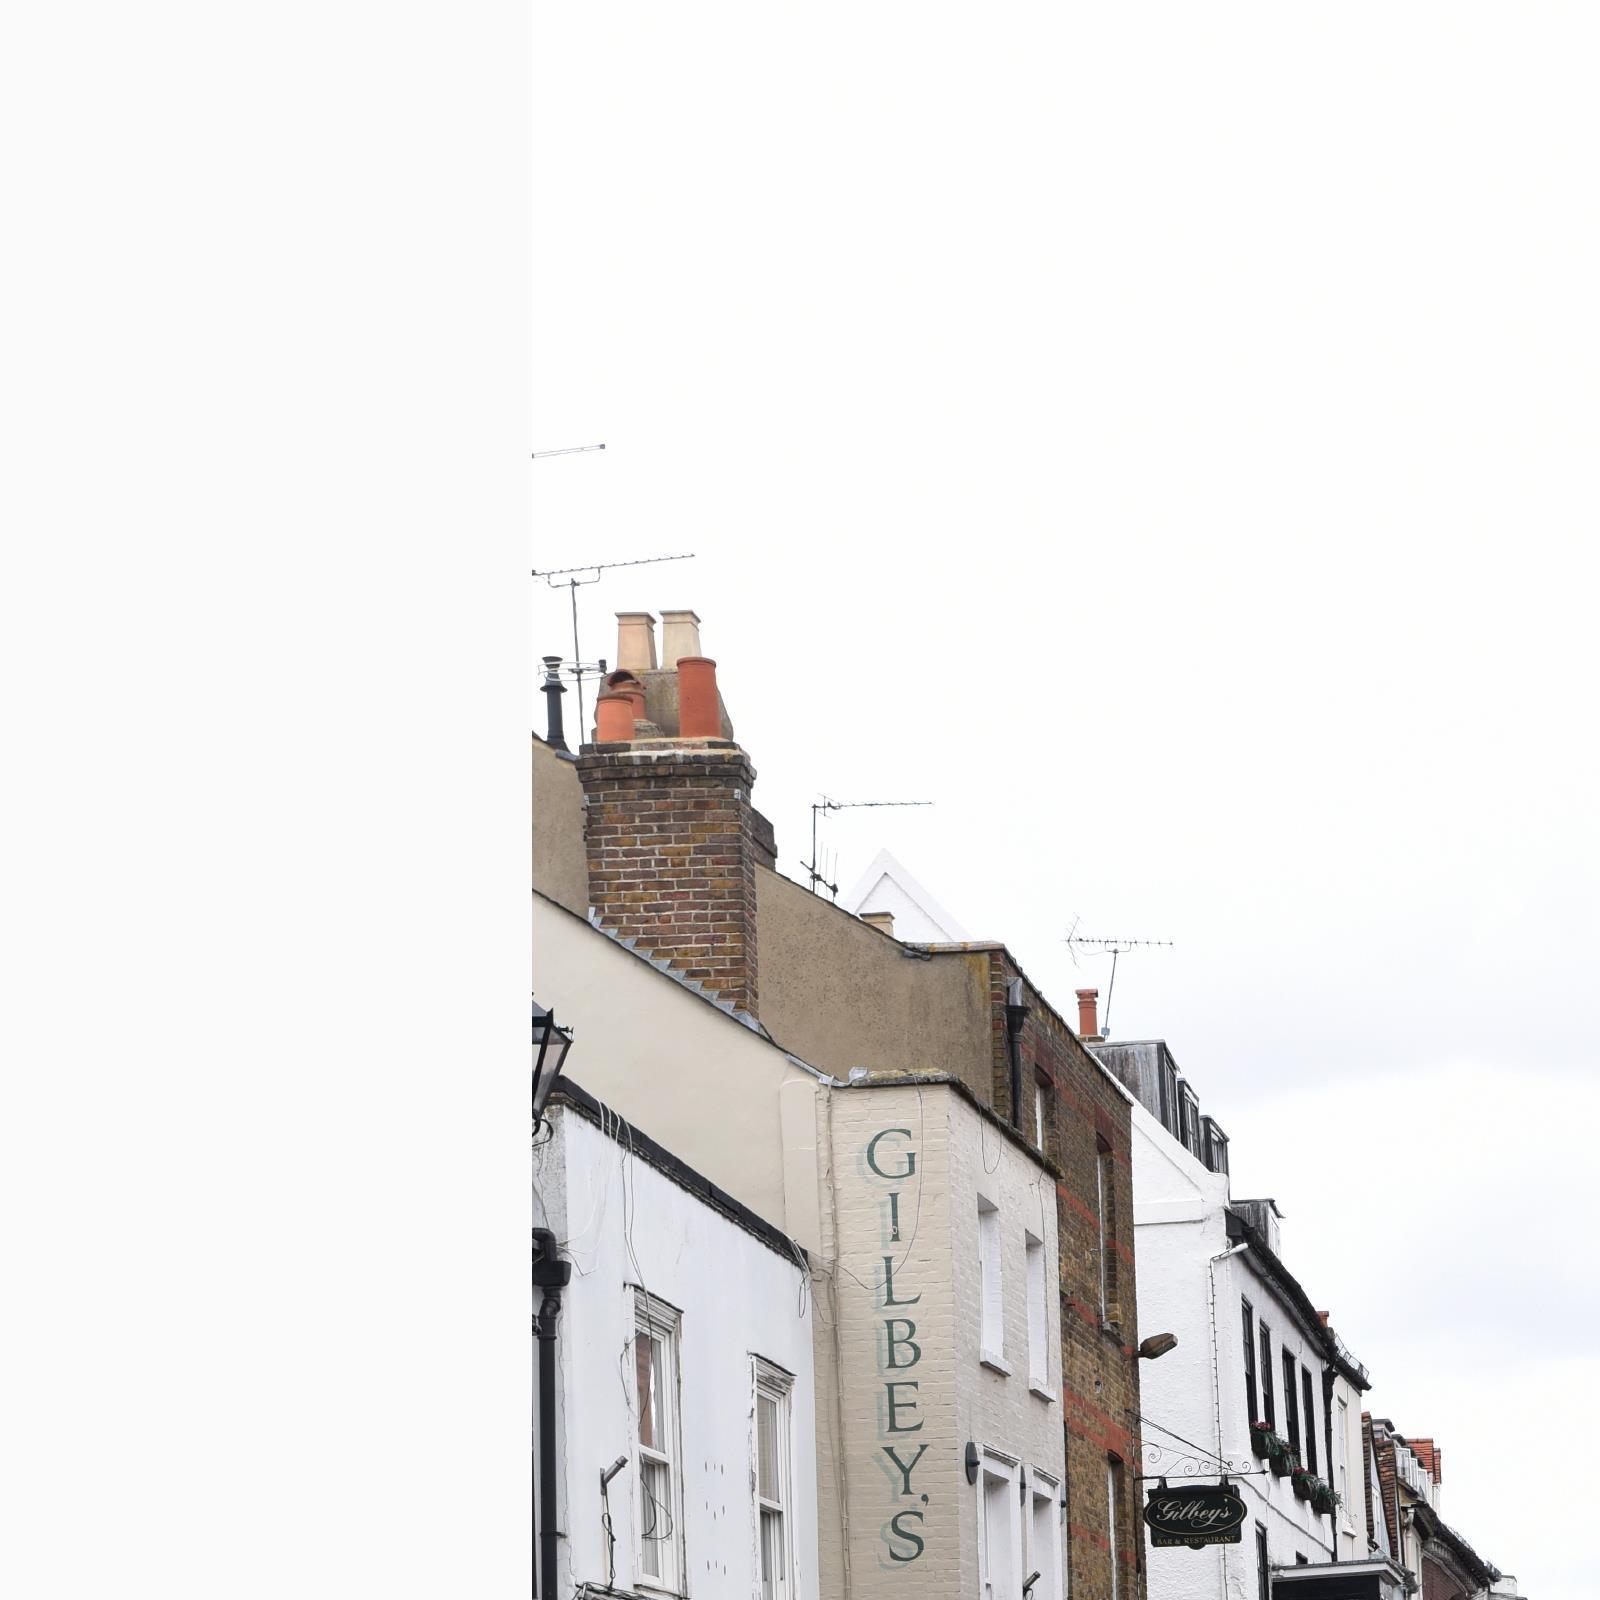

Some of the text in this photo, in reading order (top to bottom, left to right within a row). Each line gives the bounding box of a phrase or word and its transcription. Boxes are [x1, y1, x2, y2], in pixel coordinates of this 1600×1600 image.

[866, 1127, 930, 1562] GILBEY'S
[1156, 1498, 1233, 1529] Gilbey's
[1184, 1535, 1236, 1544] RESTAURANT
